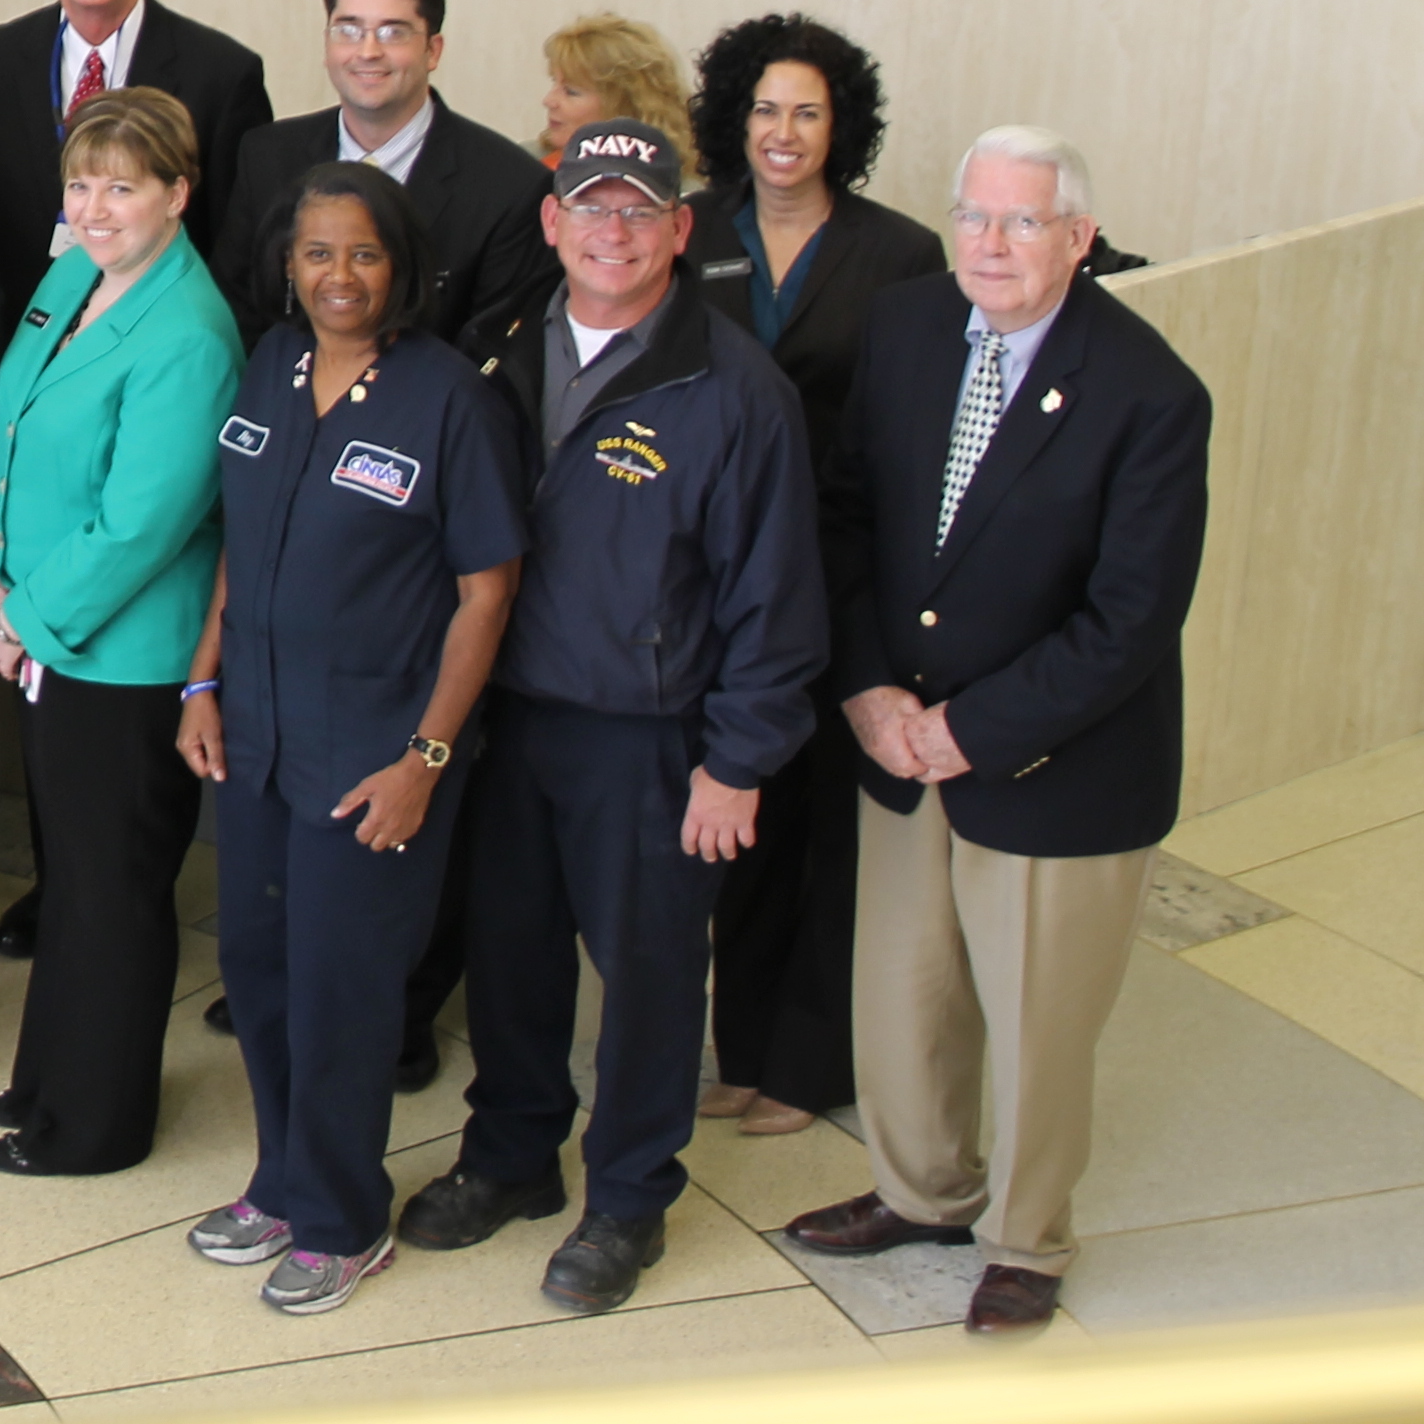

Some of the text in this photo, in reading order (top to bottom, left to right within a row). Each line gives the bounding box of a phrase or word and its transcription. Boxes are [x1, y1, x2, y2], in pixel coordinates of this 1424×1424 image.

[577, 134, 659, 164] NAVY
[596, 437, 668, 472] USS RANGER
[607, 465, 641, 485] CV-61
